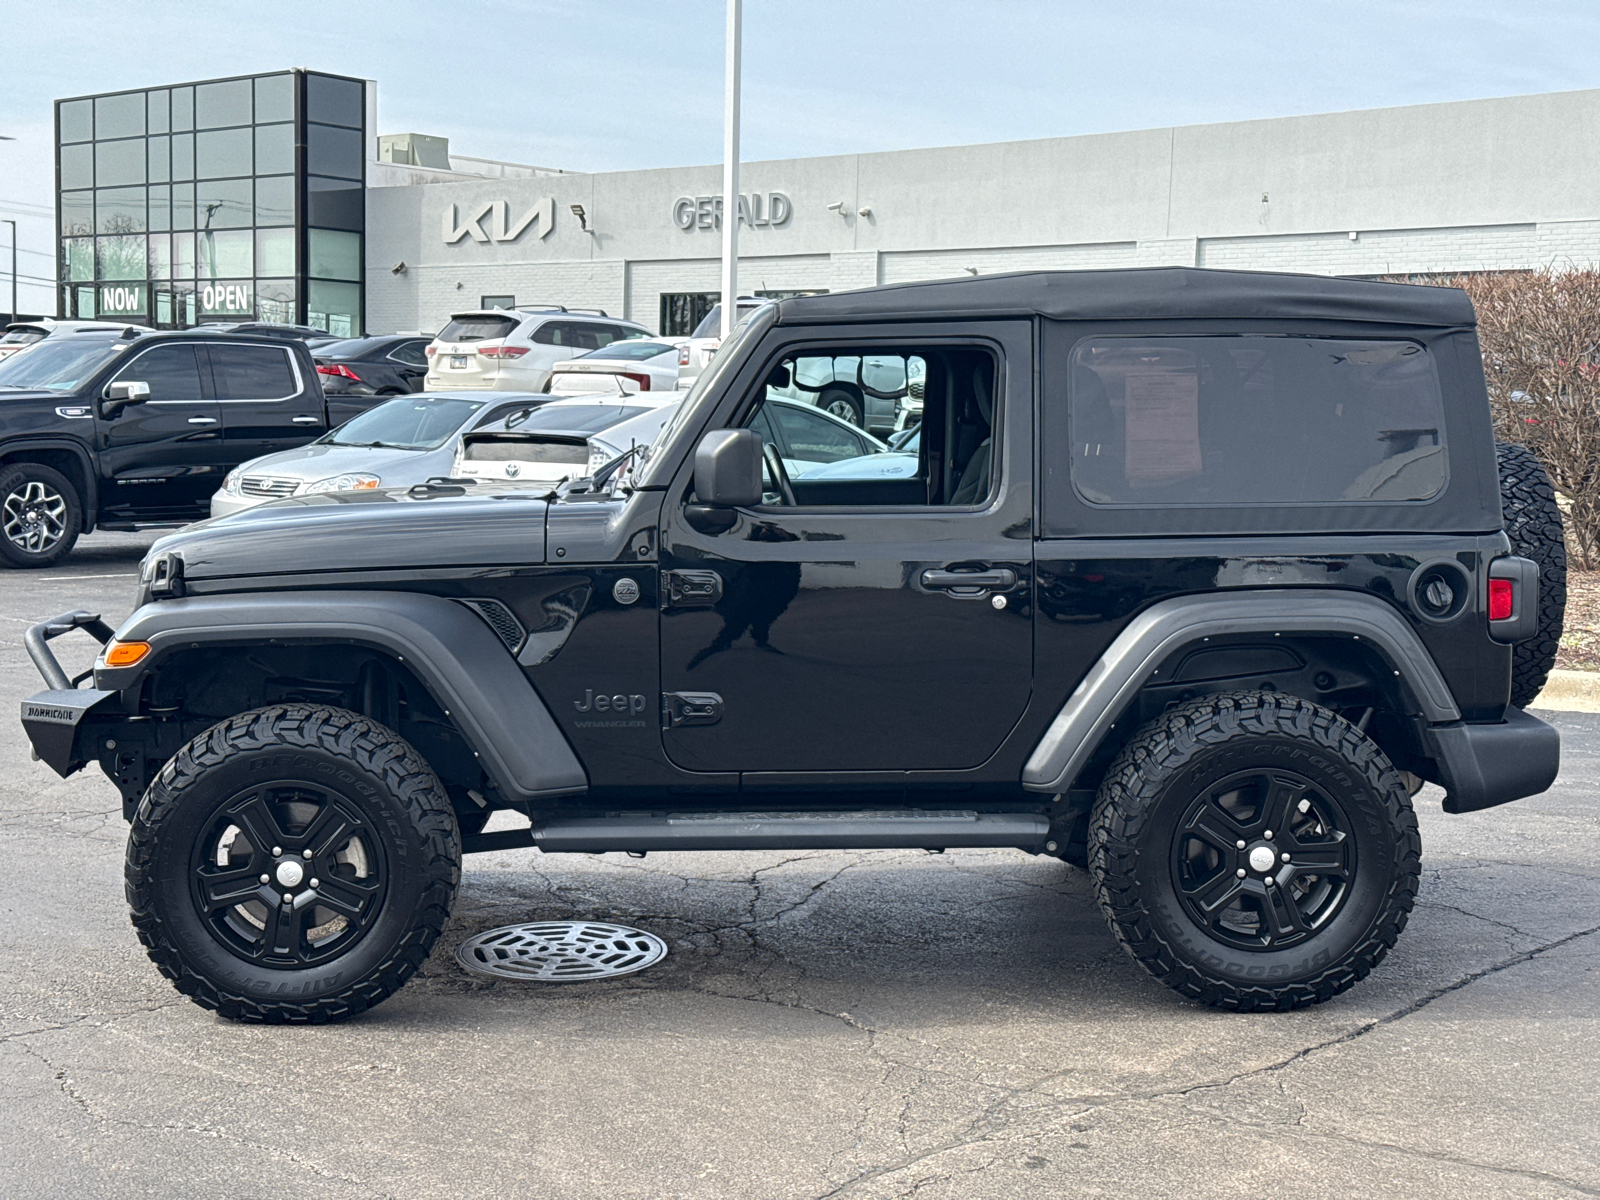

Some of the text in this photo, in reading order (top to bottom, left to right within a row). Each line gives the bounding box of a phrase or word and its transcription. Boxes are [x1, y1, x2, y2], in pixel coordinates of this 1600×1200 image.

[442, 198, 555, 244] KIA
[673, 192, 793, 231] GERALD
[103, 287, 139, 311] NOW
[203, 285, 248, 310] OPEN
[28, 707, 74, 721] BARRICADE
[574, 689, 647, 717] Jeep
[574, 720, 647, 729] WRANGLER
